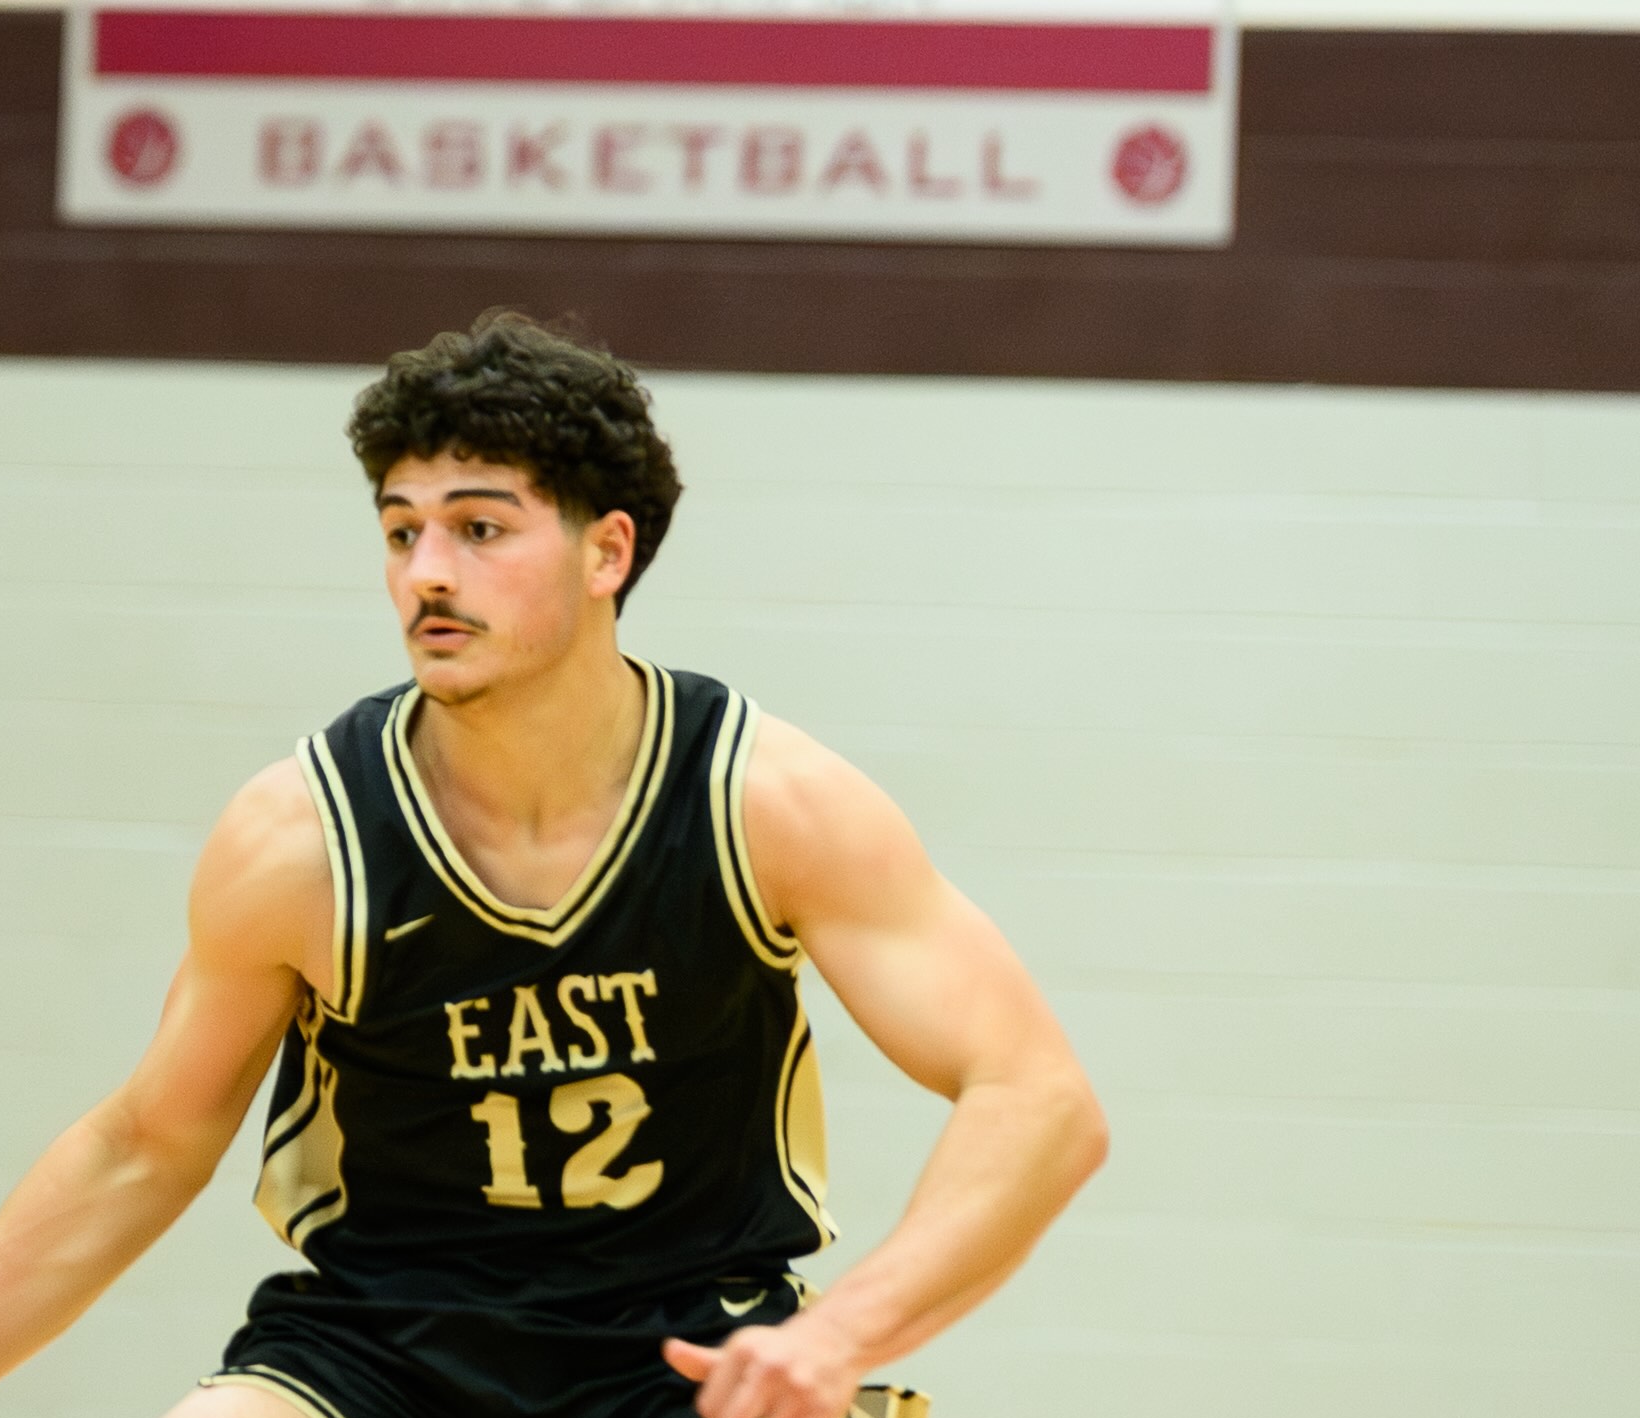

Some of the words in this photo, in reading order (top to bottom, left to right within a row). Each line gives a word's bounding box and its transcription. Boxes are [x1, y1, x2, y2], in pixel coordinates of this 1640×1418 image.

[256, 114, 1043, 202] BASKETBALL
[444, 969, 658, 1080] EAST
[470, 1072, 664, 1210] 12
